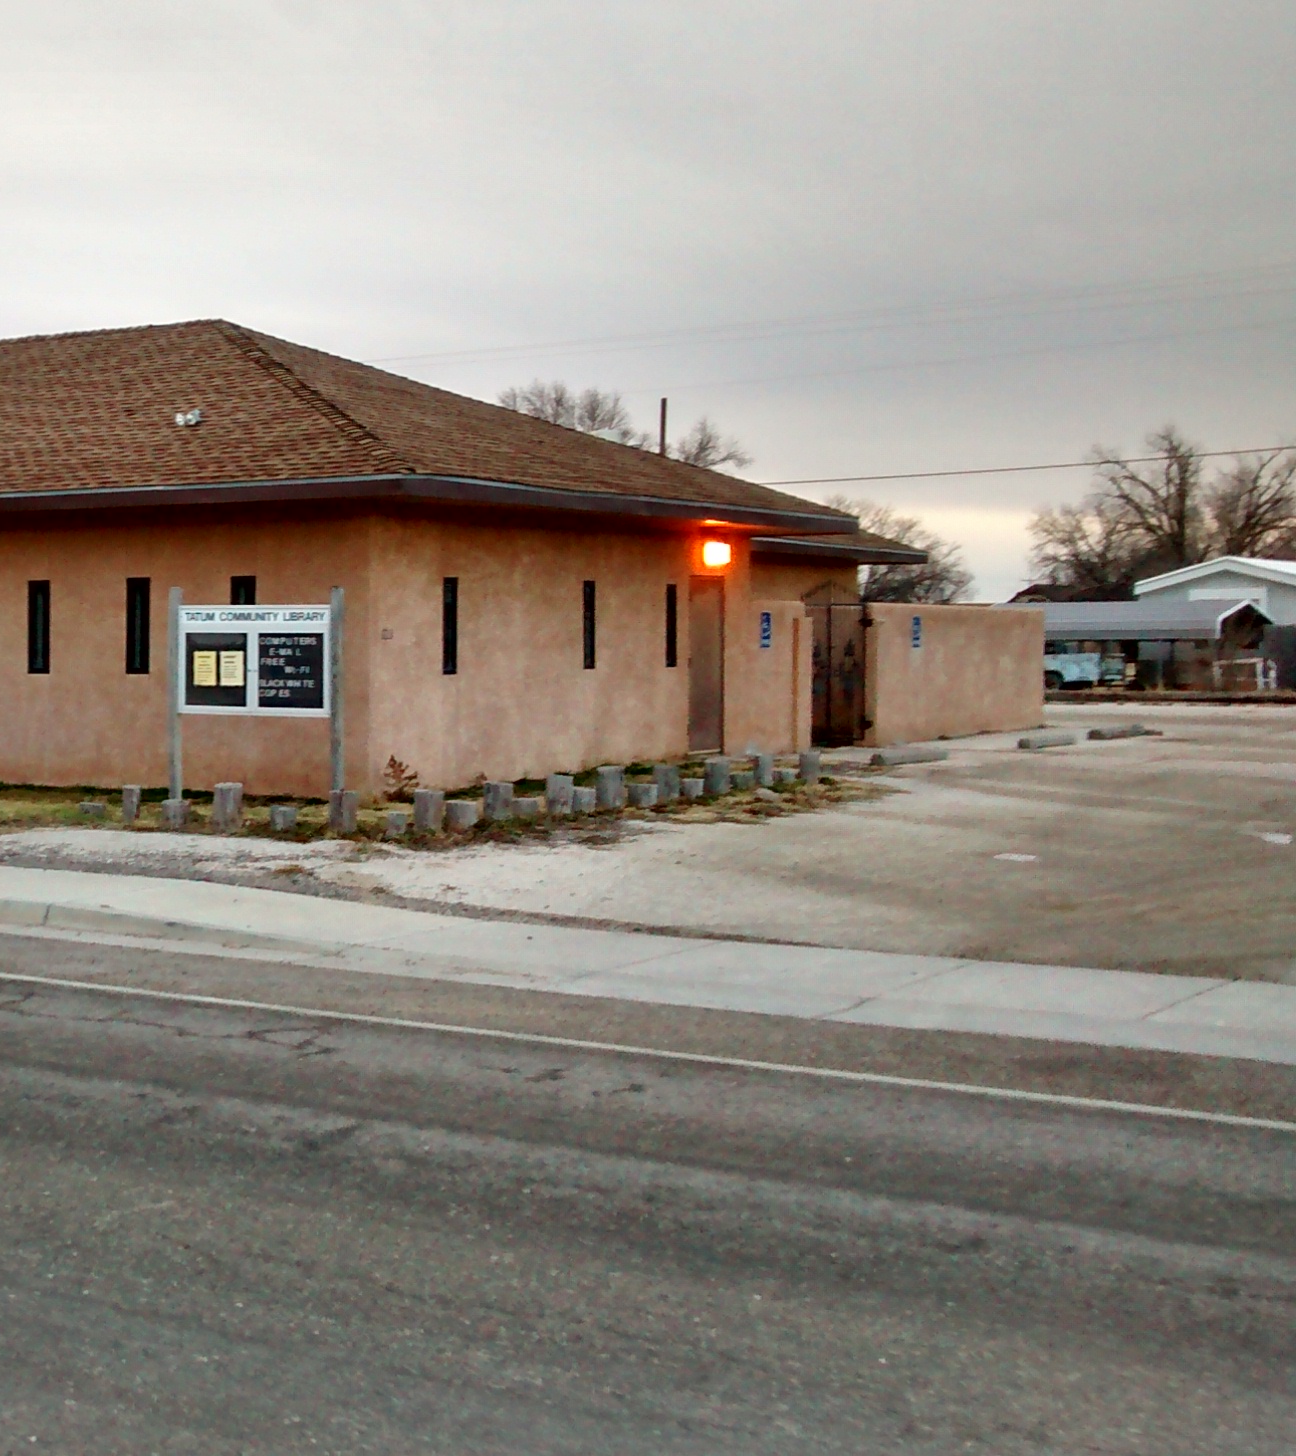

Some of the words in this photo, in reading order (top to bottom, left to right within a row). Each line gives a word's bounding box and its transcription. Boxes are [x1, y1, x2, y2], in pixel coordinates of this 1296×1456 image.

[185, 612, 215, 621] TATUM
[219, 612, 279, 621] COMMUNITY
[283, 612, 325, 621] LIBRARY
[259, 636, 317, 646] COMPUTERS
[269, 647, 302, 656] E-MAL
[260, 657, 286, 666] FREE
[285, 680, 315, 688] WHTE
[259, 689, 291, 698] COPES
